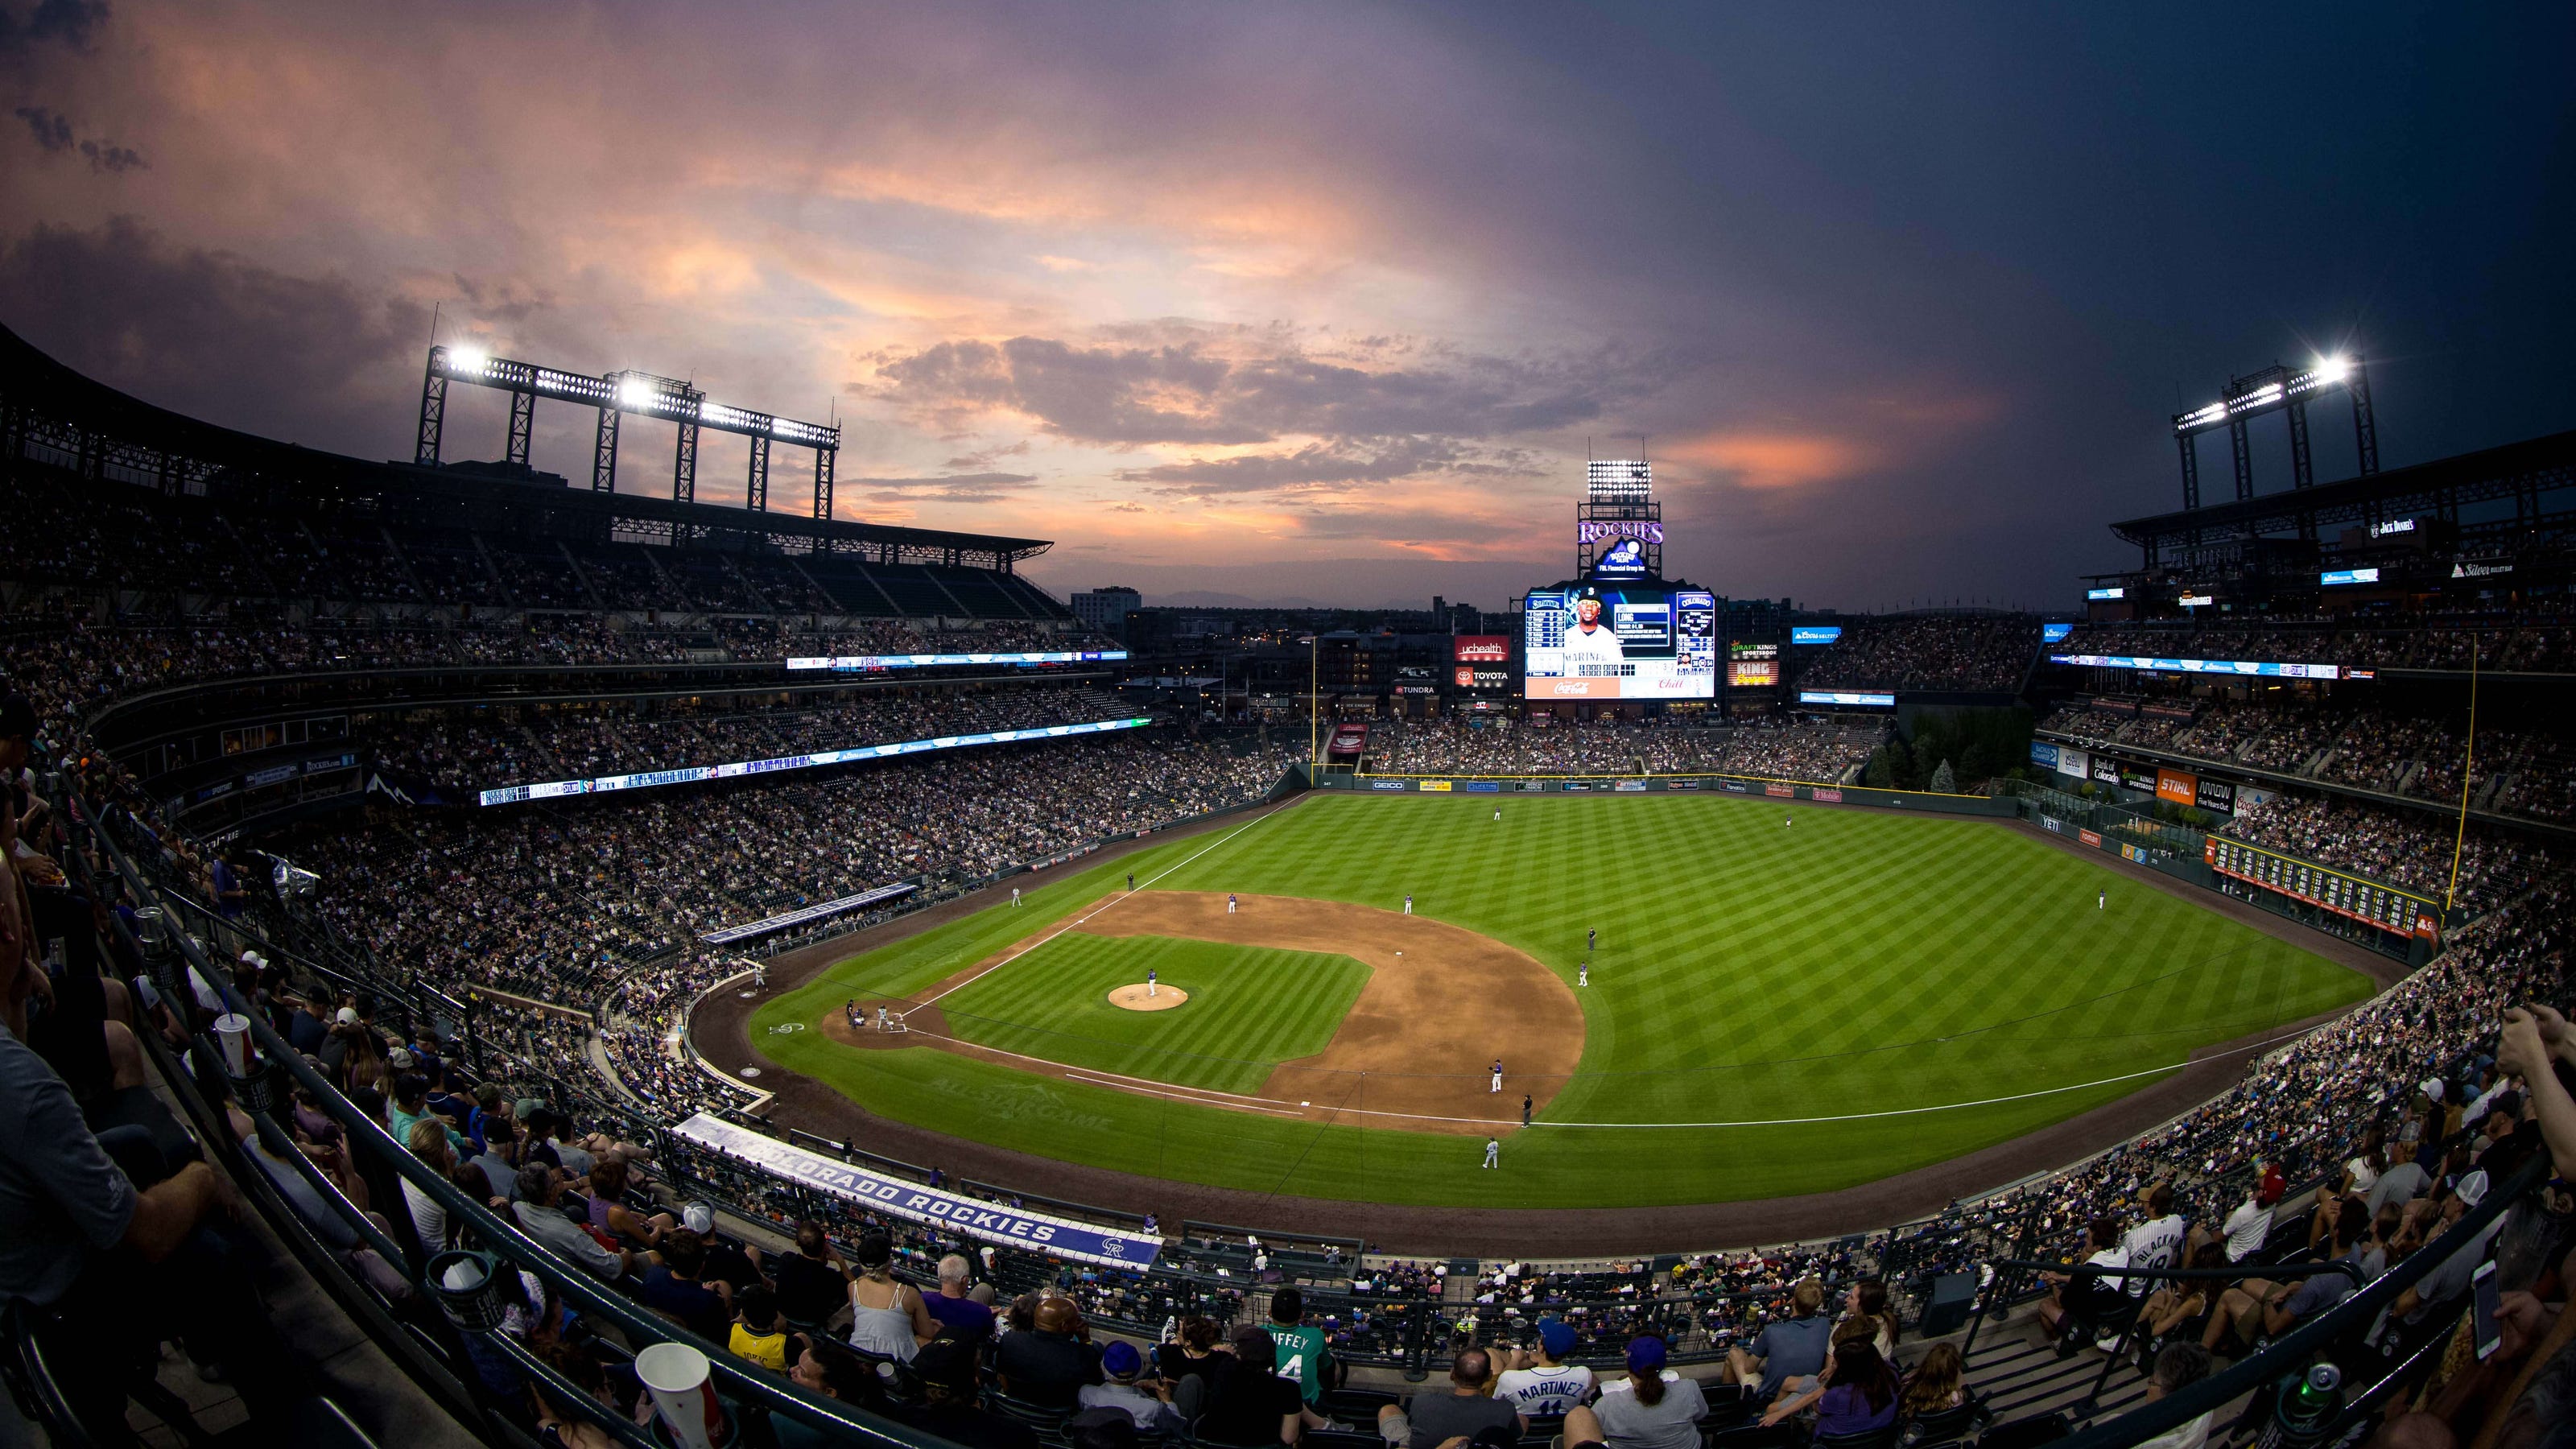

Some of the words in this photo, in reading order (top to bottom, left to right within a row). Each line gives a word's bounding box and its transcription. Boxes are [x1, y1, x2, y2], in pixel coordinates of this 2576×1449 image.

[1578, 522, 1664, 543] ROCKIES
[2380, 522, 2394, 535] JACK
[2465, 564, 2490, 576] Silver
[1682, 597, 1711, 607] COLORADO
[1618, 613, 1634, 621] LONG
[1802, 631, 1818, 639] Coors
[1462, 643, 1501, 653] uchealth
[1732, 644, 1777, 652] DRAFTKINGS
[1737, 663, 1769, 675] KING
[1659, 677, 1683, 688] Chill
[2066, 754, 2080, 768] Coors
[2095, 758, 2108, 770] Bank
[2108, 761, 2116, 771] of
[2095, 769, 2119, 783] Colorado
[2128, 780, 2154, 791] SPORTSBOOK
[2161, 778, 2190, 796] STIHL
[1820, 791, 1840, 799] Mobile
[2198, 797, 2207, 807] Five
[2207, 799, 2220, 809] Years
[2219, 802, 2229, 811] Out
[2042, 817, 2059, 832] YETI
[2082, 832, 2099, 844] roman
[836, 888, 894, 909] WELCOME
[775, 909, 815, 924] COORS
[729, 920, 773, 935] FIELD
[906, 1193, 1057, 1241] ROCKIES
[2137, 1234, 2178, 1262] BLACKM
[1269, 1331, 1309, 1350] IFFEY
[1517, 1381, 1584, 1402] MARTINEZ
[1539, 1399, 1562, 1415] 11
